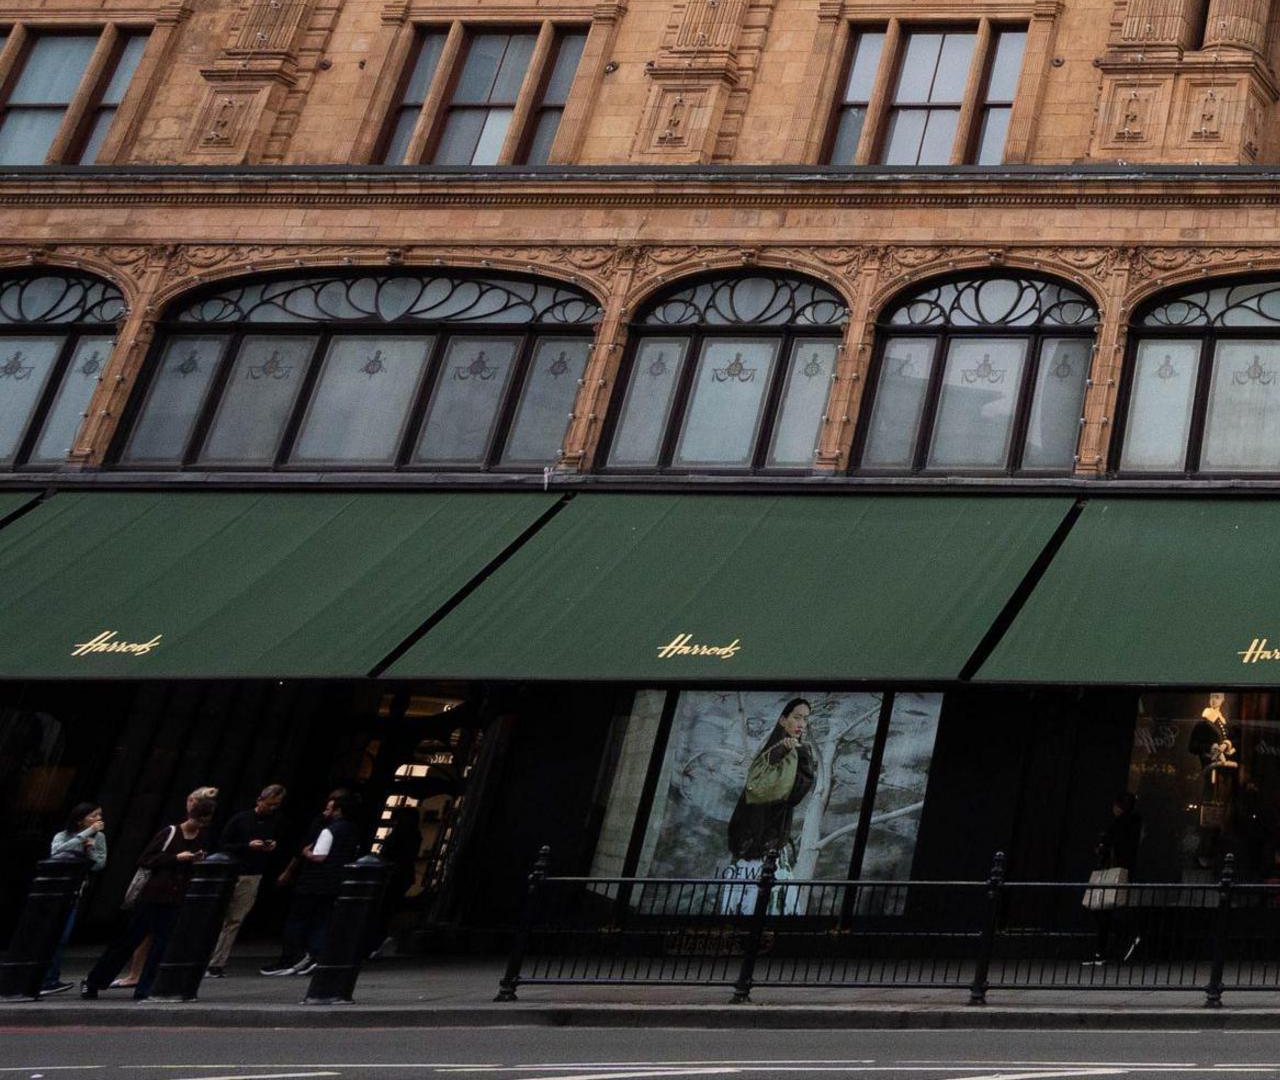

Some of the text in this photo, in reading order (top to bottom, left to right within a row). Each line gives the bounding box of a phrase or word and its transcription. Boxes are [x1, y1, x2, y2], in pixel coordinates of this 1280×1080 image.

[71, 630, 163, 657] Harrods
[656, 633, 741, 659] Harrods
[714, 866, 764, 880] LOEW
